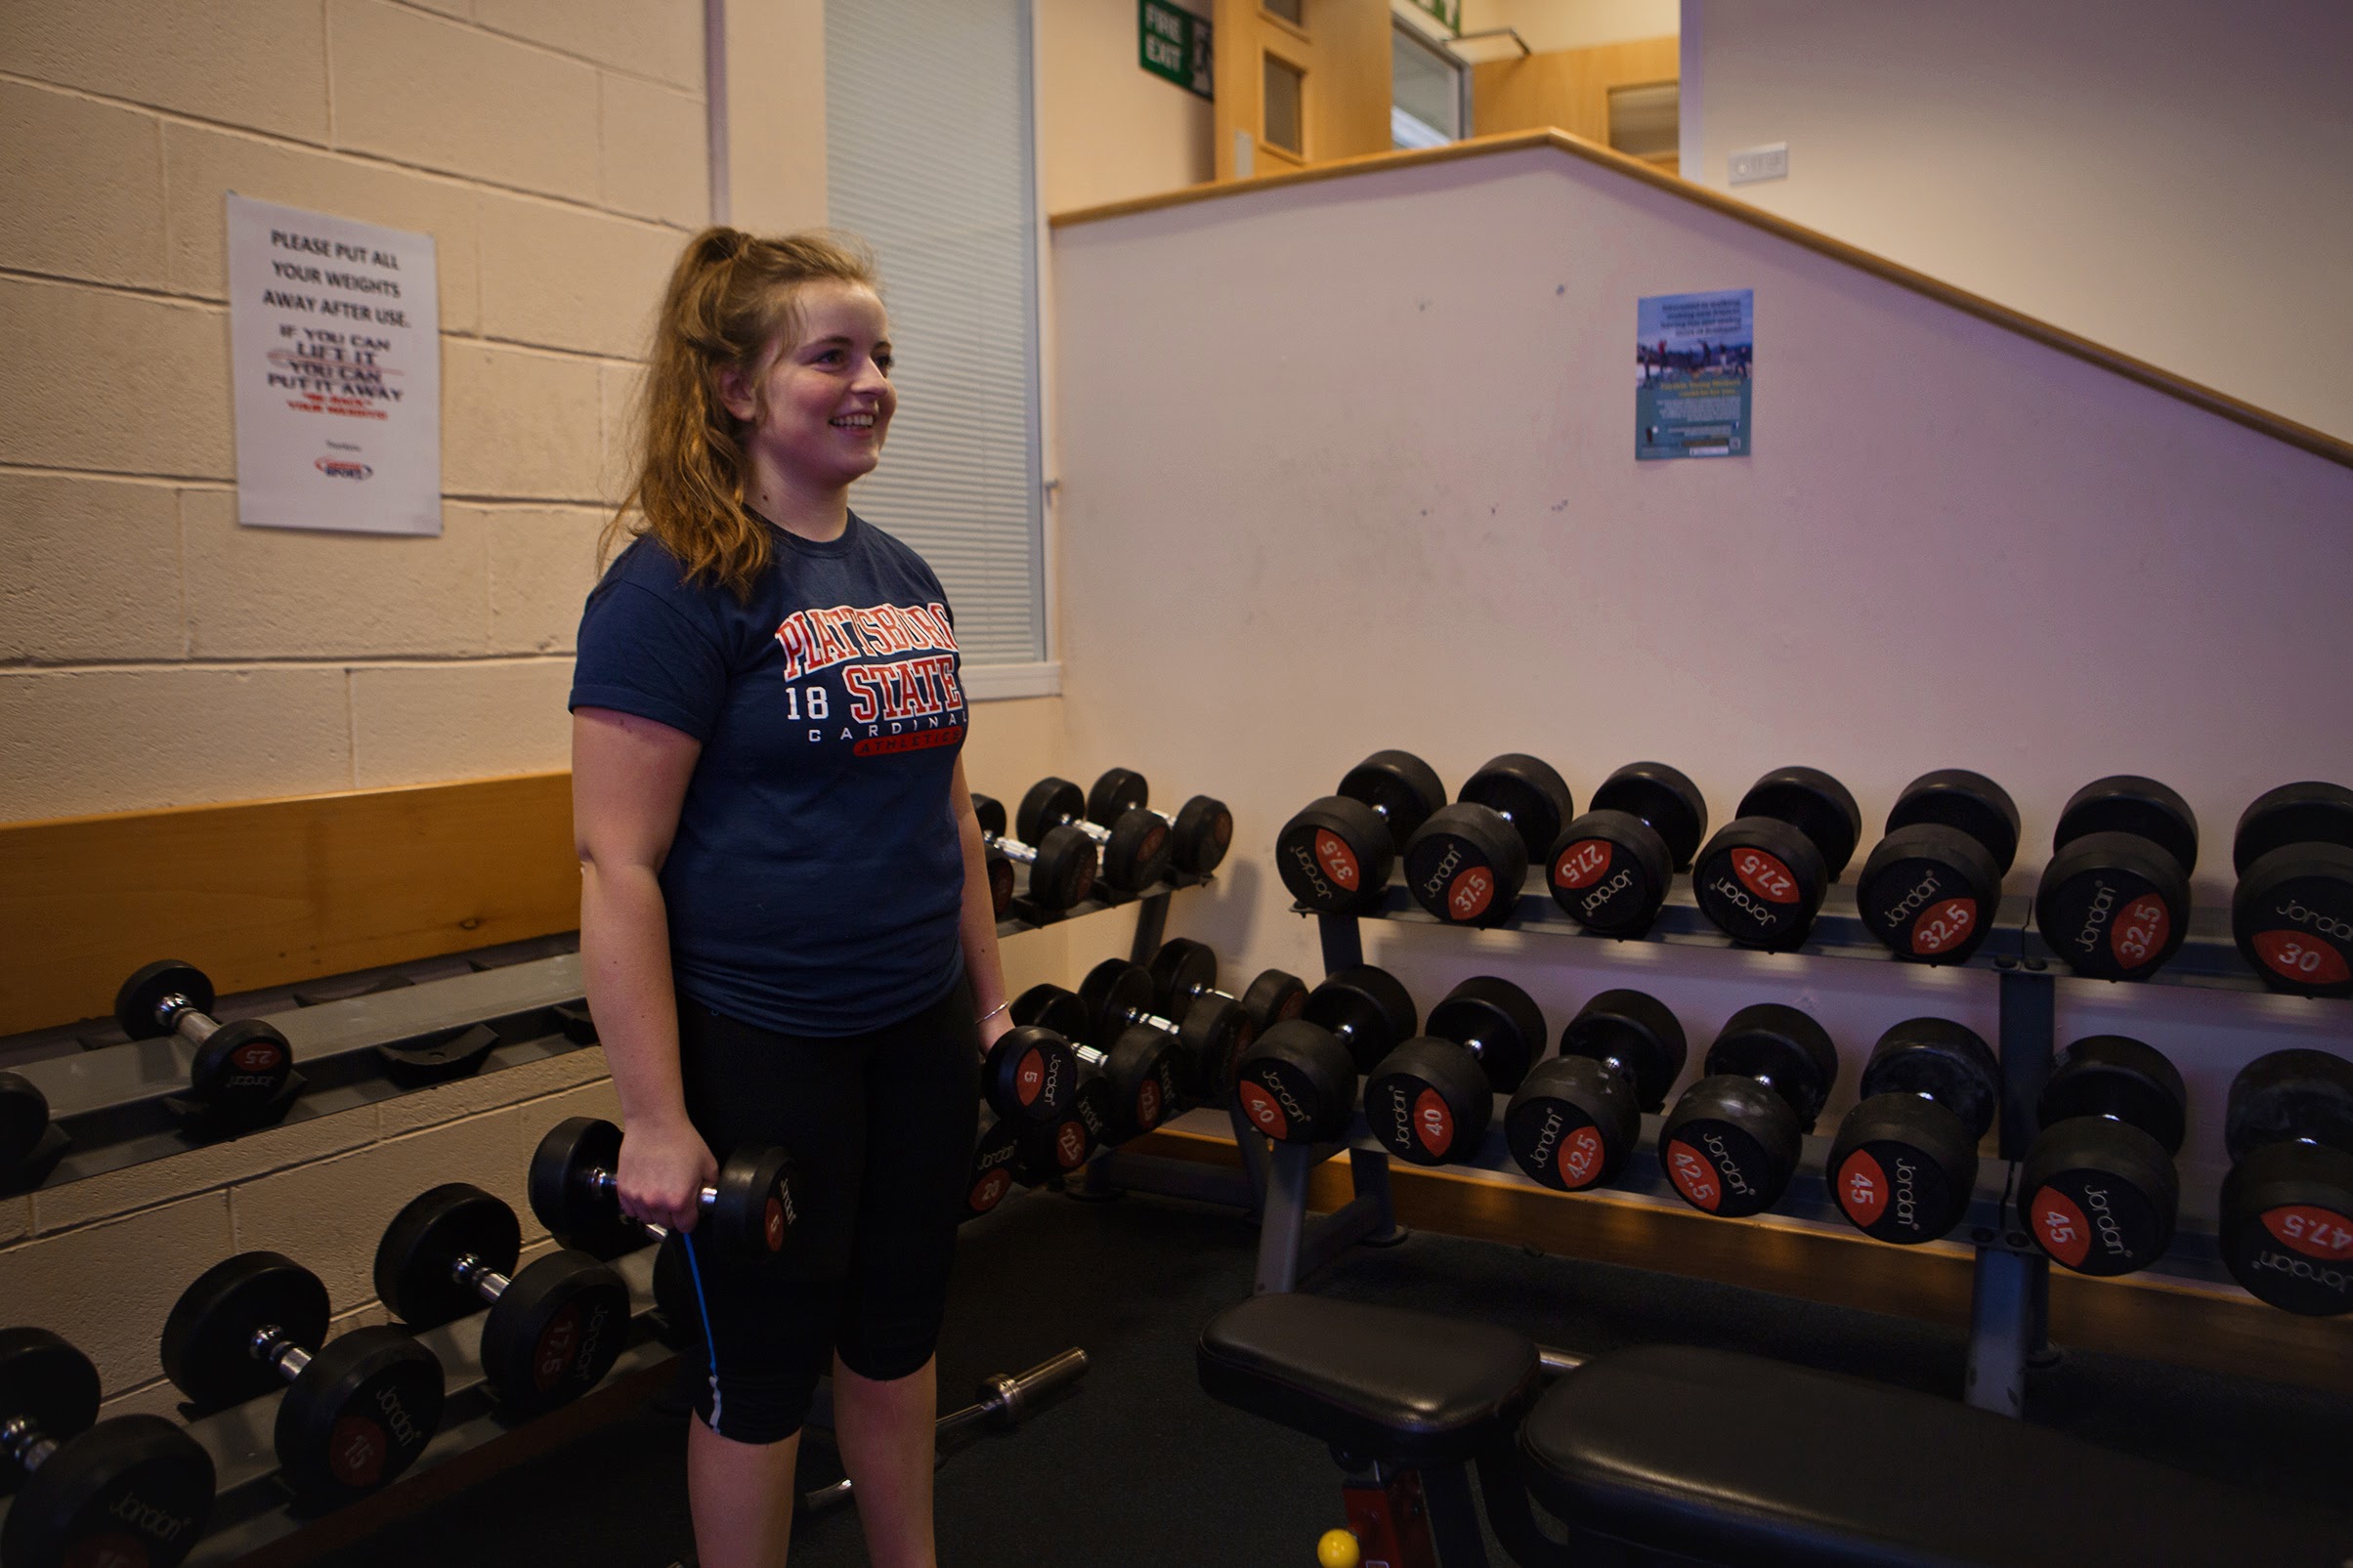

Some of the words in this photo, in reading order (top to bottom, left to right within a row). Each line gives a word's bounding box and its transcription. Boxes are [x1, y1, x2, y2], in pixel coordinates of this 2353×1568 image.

[1146, 2, 1181, 45] FIRE
[1145, 32, 1181, 73] EXIT
[272, 230, 331, 258] PLEASE
[335, 241, 367, 264] PUT
[372, 249, 401, 272] ALL
[273, 259, 322, 284] YOUR
[324, 270, 402, 299] WEIGHTS
[263, 288, 316, 312] AWAY
[320, 298, 372, 321] AFTER
[296, 340, 344, 361] LIFT
[353, 350, 375, 366] IT
[303, 327, 345, 344] YOU
[350, 334, 391, 352] CAN
[268, 372, 311, 389] PUT
[314, 378, 335, 392] IT
[342, 382, 404, 402] AWAY
[786, 686, 829, 720] 18
[841, 655, 963, 724] STATE
[860, 730, 962, 753] ATHLETICS
[1321, 840, 1352, 880] 37.5
[1562, 844, 1604, 882] 27.5
[1740, 855, 1791, 896] 27.5
[1455, 874, 1486, 911] 37.5
[1918, 904, 1969, 950] 32.5
[2120, 904, 2160, 959] 32.5
[2279, 943, 2321, 972] 30
[1024, 1071, 1038, 1083] 5
[1251, 1099, 1274, 1123] 40
[1424, 1109, 1443, 1136] 40
[1566, 1134, 1597, 1181] 42.5
[1674, 1153, 1715, 1201] 42.5
[1850, 1172, 1874, 1205] 45
[2045, 1210, 2078, 1244] 45
[2282, 1214, 2353, 1250] 47.5
[344, 1435, 372, 1469] 15
